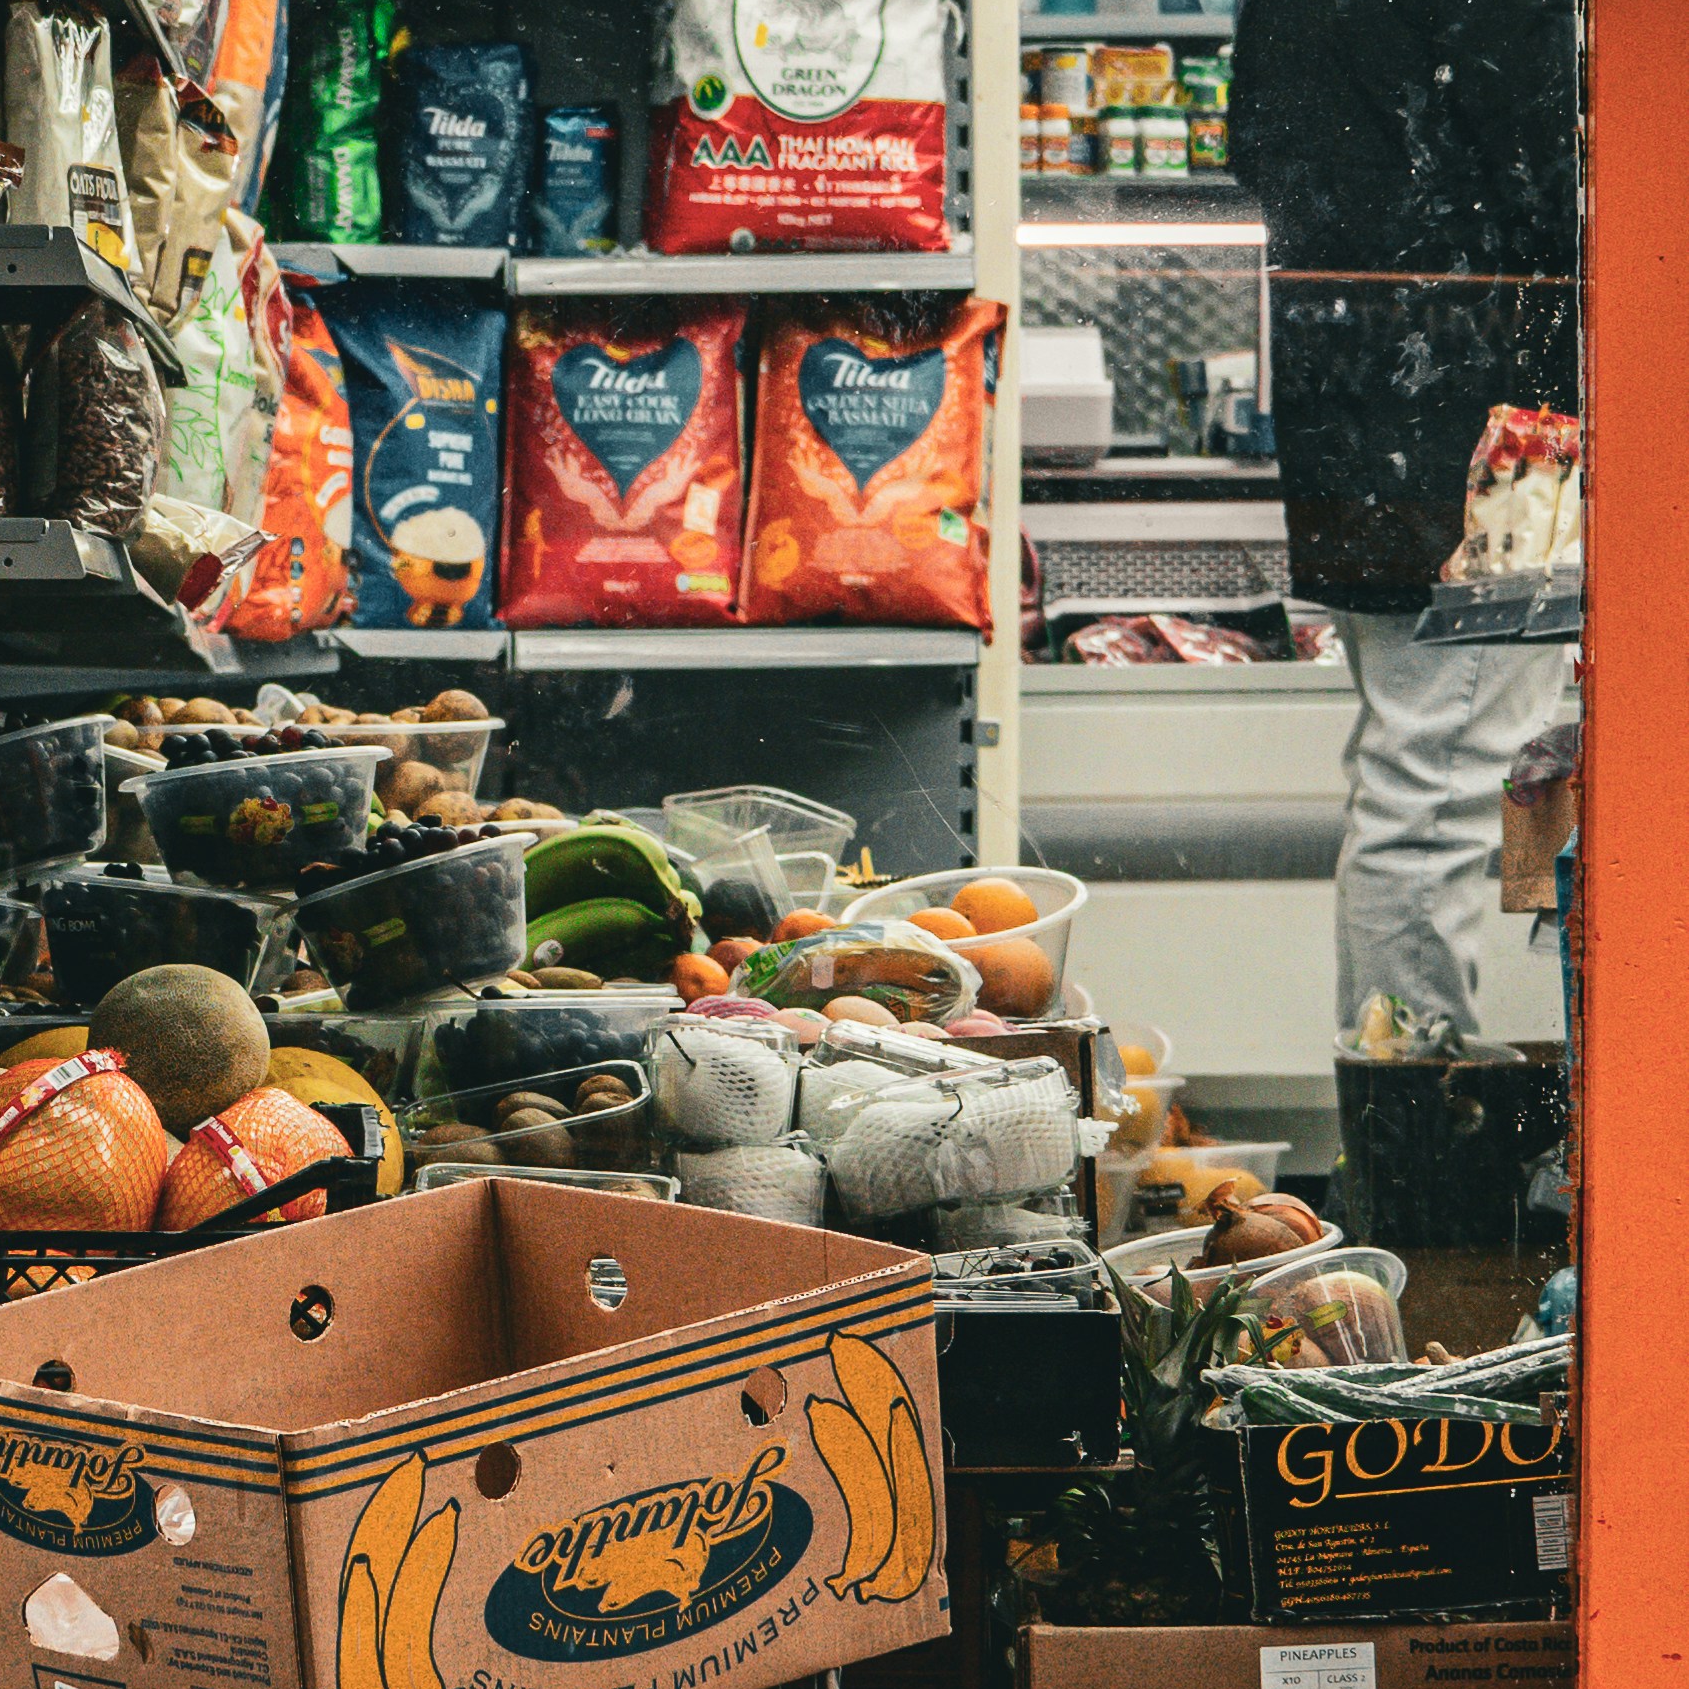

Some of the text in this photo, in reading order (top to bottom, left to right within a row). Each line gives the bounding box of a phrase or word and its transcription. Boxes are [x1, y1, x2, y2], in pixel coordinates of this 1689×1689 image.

[782, 68, 837, 81] GREEN
[772, 83, 847, 97] DRAGON
[423, 106, 488, 138] Tilda
[546, 139, 594, 162] Tilda
[691, 134, 774, 170] AAA
[778, 135, 823, 154] THAI
[778, 152, 877, 171] FRAGRANT
[70, 170, 96, 197] OATS
[333, 147, 355, 232] DAAWAT
[581, 357, 667, 393] Tilda
[823, 352, 911, 389] Tilda
[417, 377, 476, 402] DISHA
[577, 394, 621, 410] EASY
[573, 409, 624, 424] LONG
[520, 1447, 786, 1581] Jolanthe
[73, 1519, 143, 1549] PREMIUM
[527, 1547, 782, 1648] PREMIUM PLANTAINS
[1280, 1647, 1358, 1662] PINEAPPLES
[1411, 1638, 1470, 1655] Product
[1473, 1636, 1490, 1653] of
[1494, 1637, 1539, 1652] Costa
[1327, 1673, 1358, 1684] CLASS
[1425, 1665, 1492, 1681] Ananas
